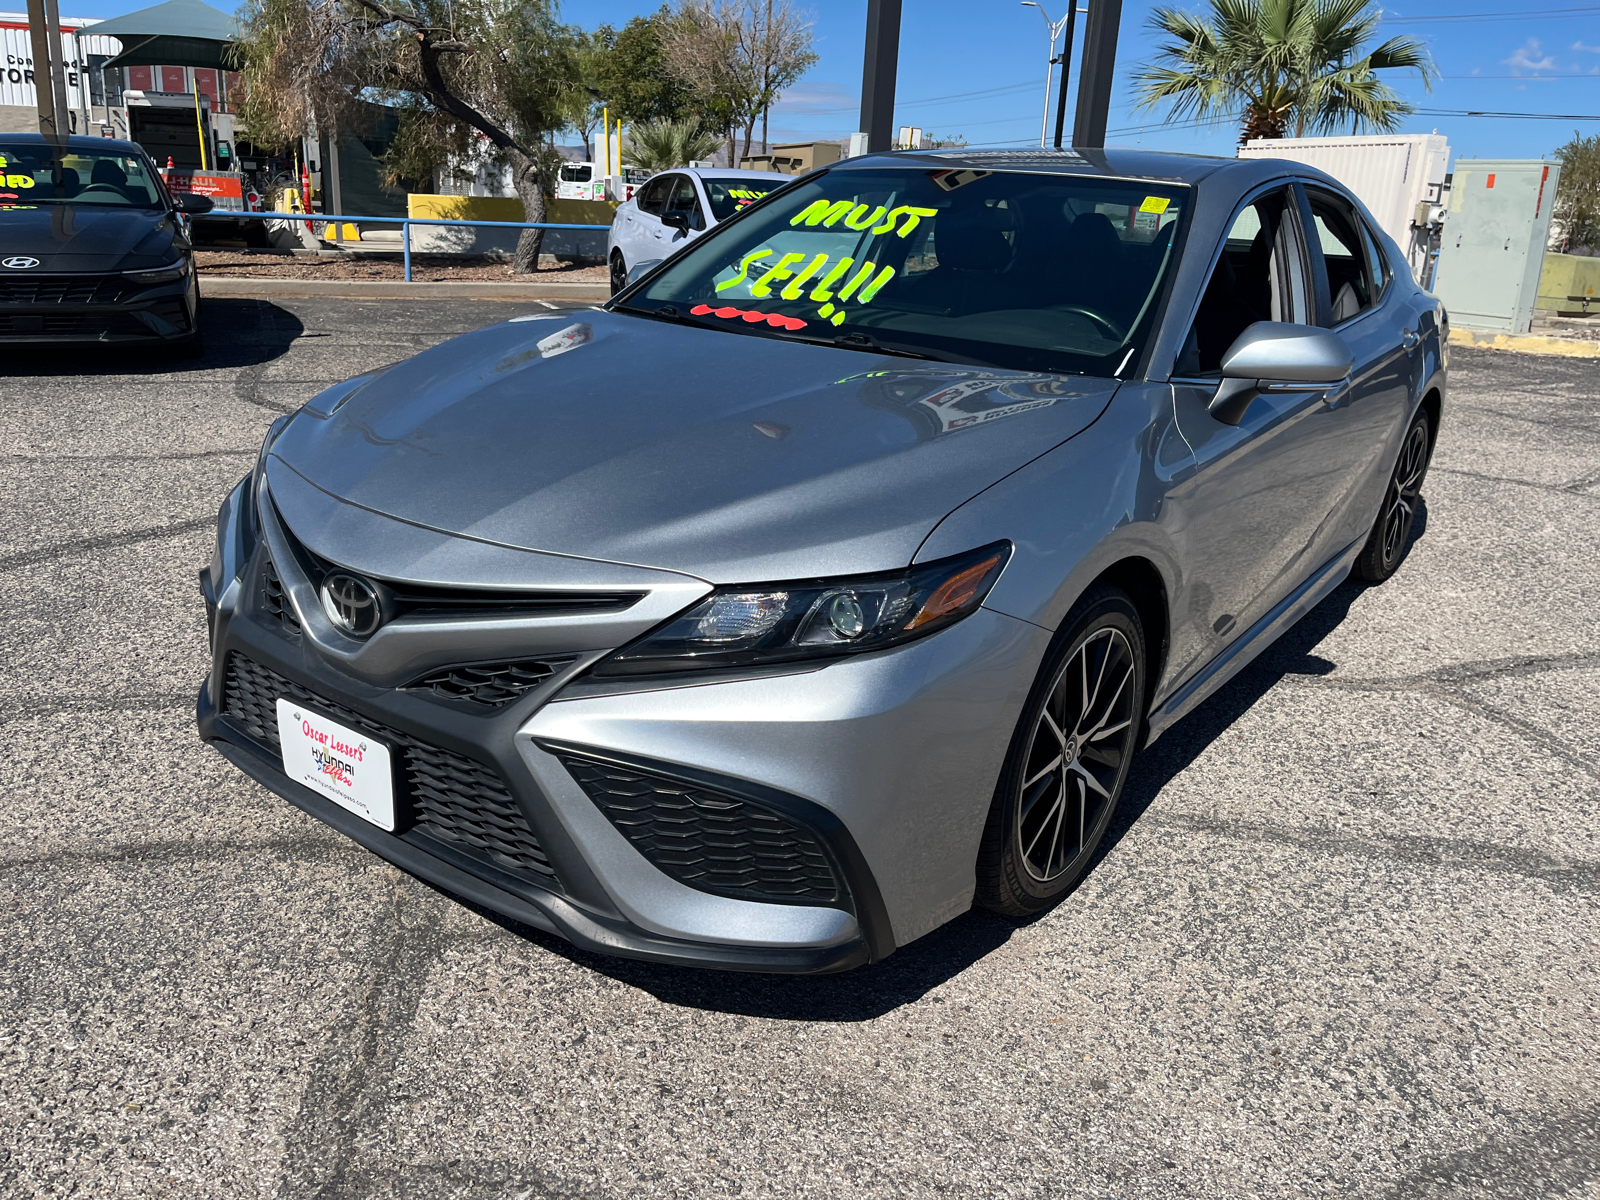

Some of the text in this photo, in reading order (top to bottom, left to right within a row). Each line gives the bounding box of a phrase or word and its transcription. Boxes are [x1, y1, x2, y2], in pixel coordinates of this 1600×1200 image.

[790, 199, 939, 238] MUST
[302, 720, 363, 762] Oscar Leeser's
[311, 747, 355, 776] HYUNDAI
[324, 764, 352, 787] El Paso
